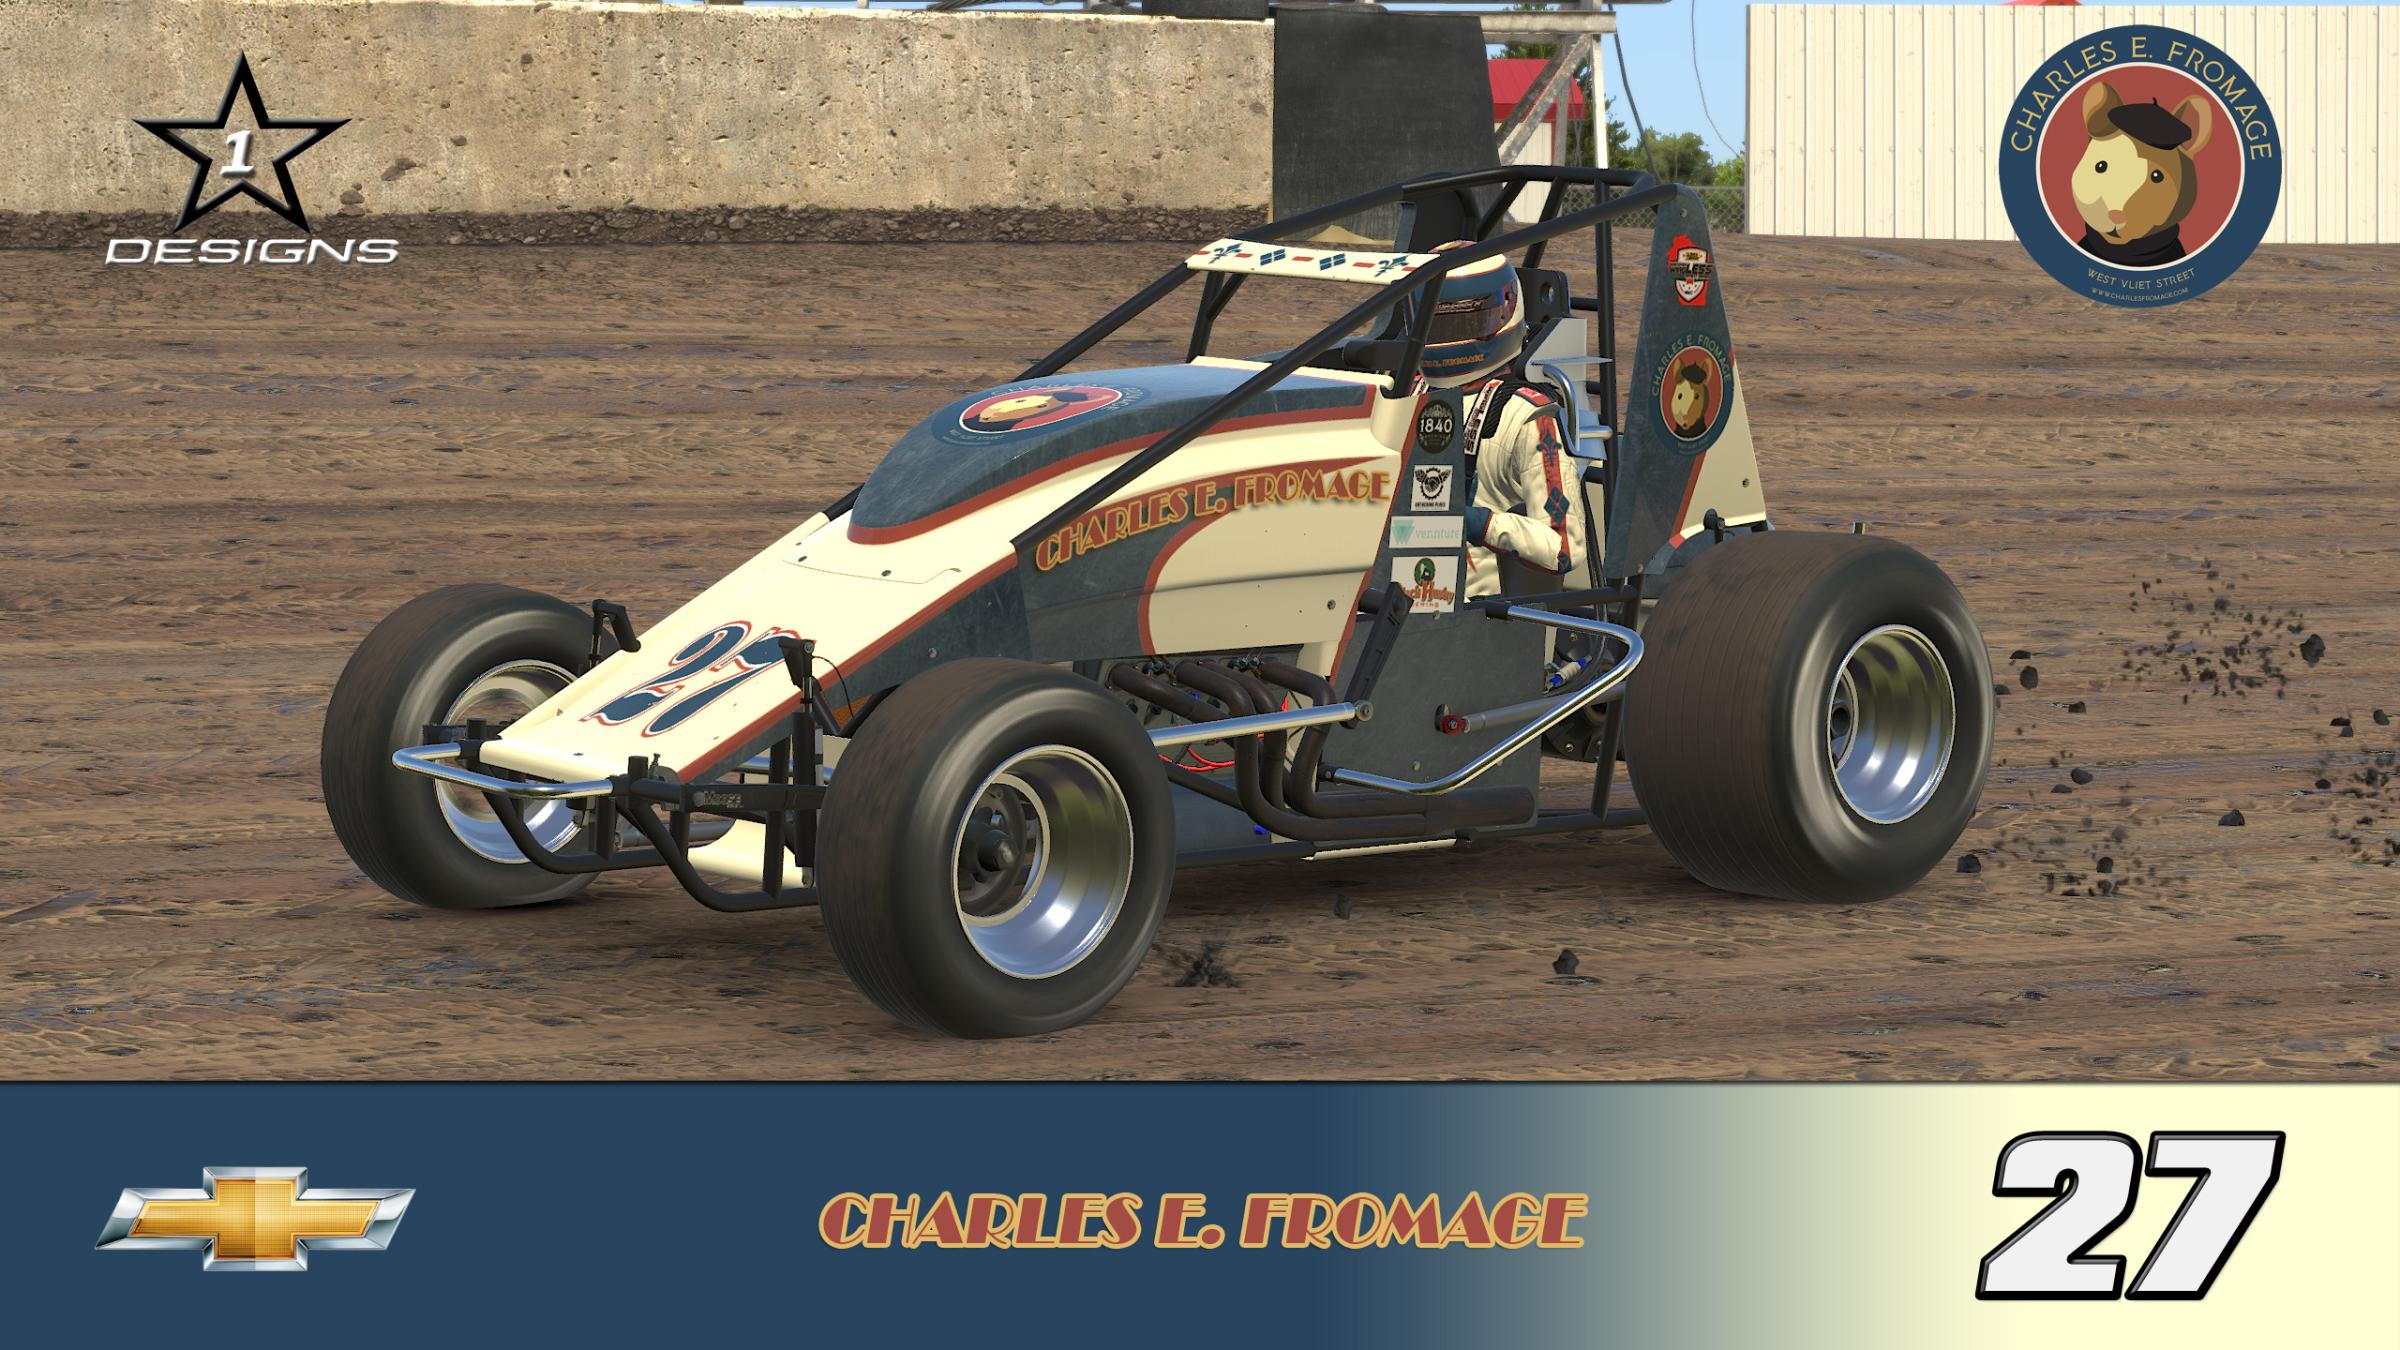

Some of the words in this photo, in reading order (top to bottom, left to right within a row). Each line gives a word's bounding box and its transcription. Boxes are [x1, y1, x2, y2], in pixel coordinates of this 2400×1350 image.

[1652, 337, 1684, 396] CHARLES
[1698, 334, 1731, 382] FROMAGE
[1420, 418, 1453, 433] 1840
[1035, 488, 1189, 571] CHARLES
[1194, 482, 1228, 518] E.
[1233, 467, 1391, 510] FROMAGE
[578, 620, 817, 738] 27
